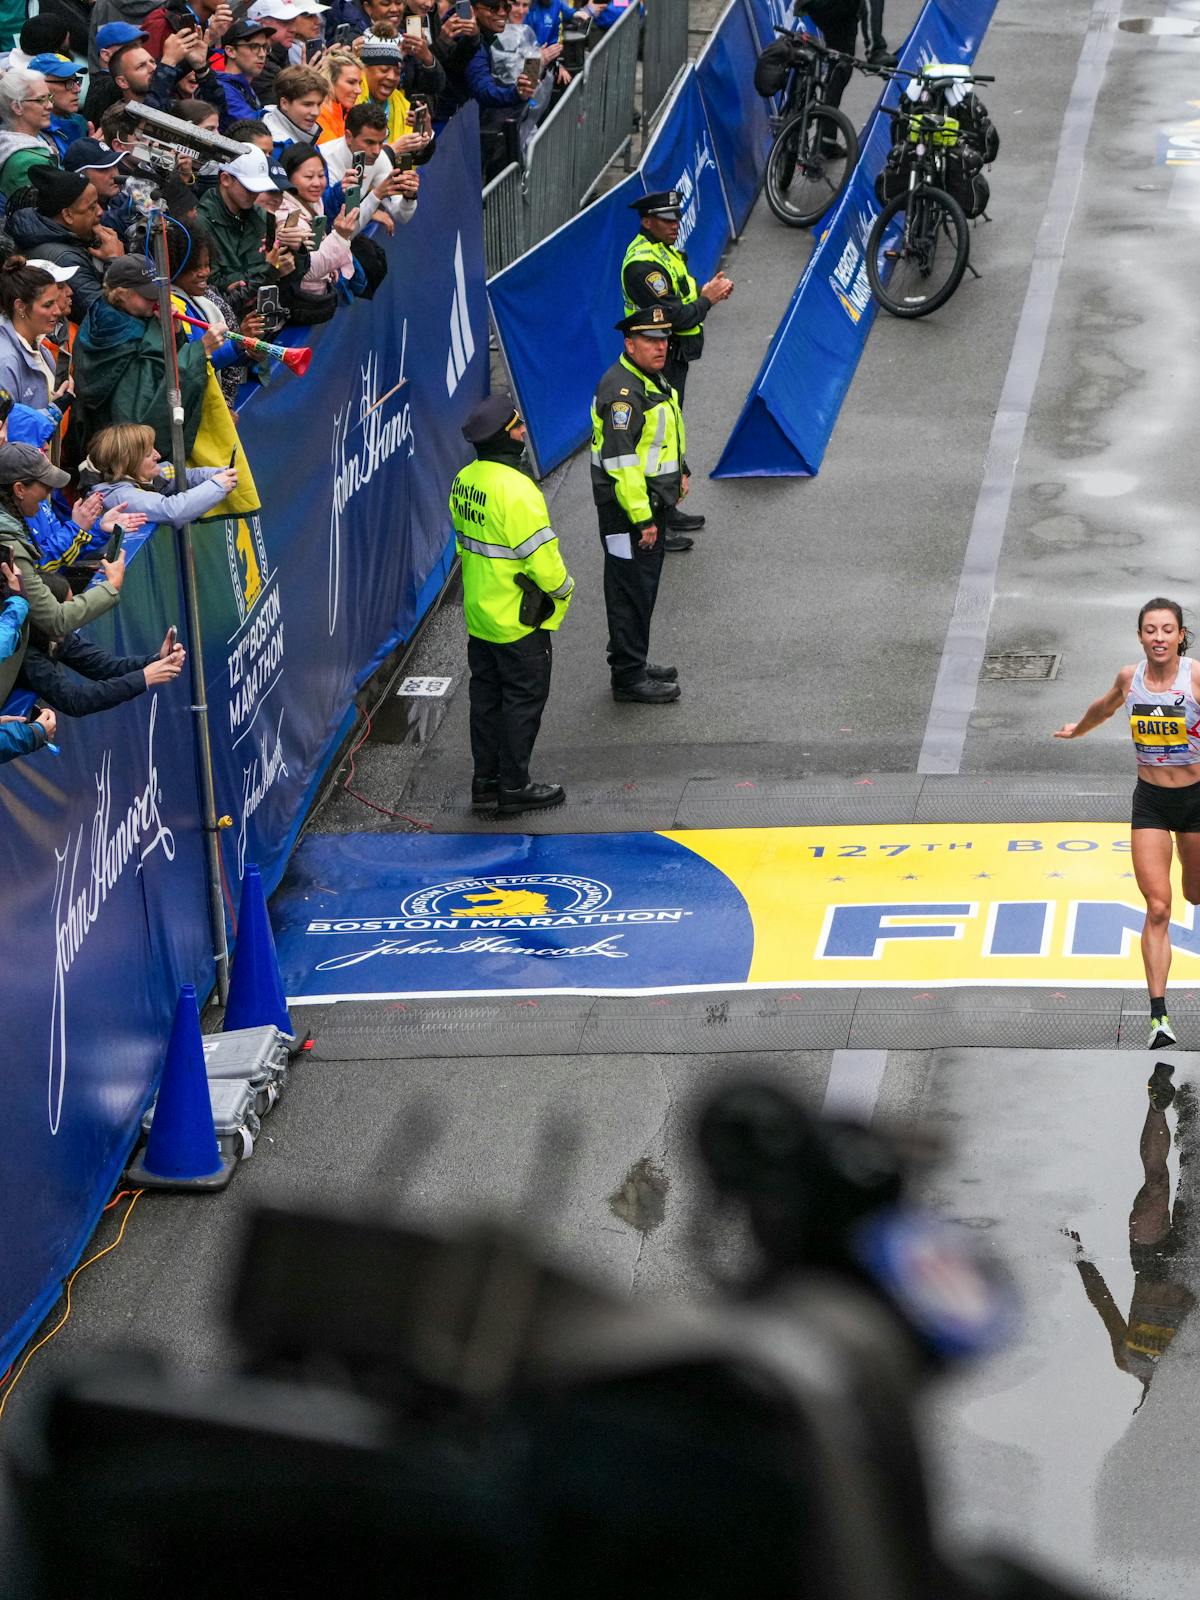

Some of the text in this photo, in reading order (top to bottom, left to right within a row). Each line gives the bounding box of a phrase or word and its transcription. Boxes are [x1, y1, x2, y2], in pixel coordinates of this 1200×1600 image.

[452, 476, 486, 507] Boston
[453, 497, 485, 527] Police
[250, 583, 281, 661] BOSTON
[229, 629, 284, 734] MARATHON
[1137, 720, 1179, 736] BATES
[808, 841, 973, 858] 127TH
[410, 876, 603, 914] BOSTON ATHLETIC ASSOCIATION
[306, 911, 683, 932] BOSTON MARATHON
[315, 934, 629, 971] John Hancock
[48, 823, 92, 1135] John
